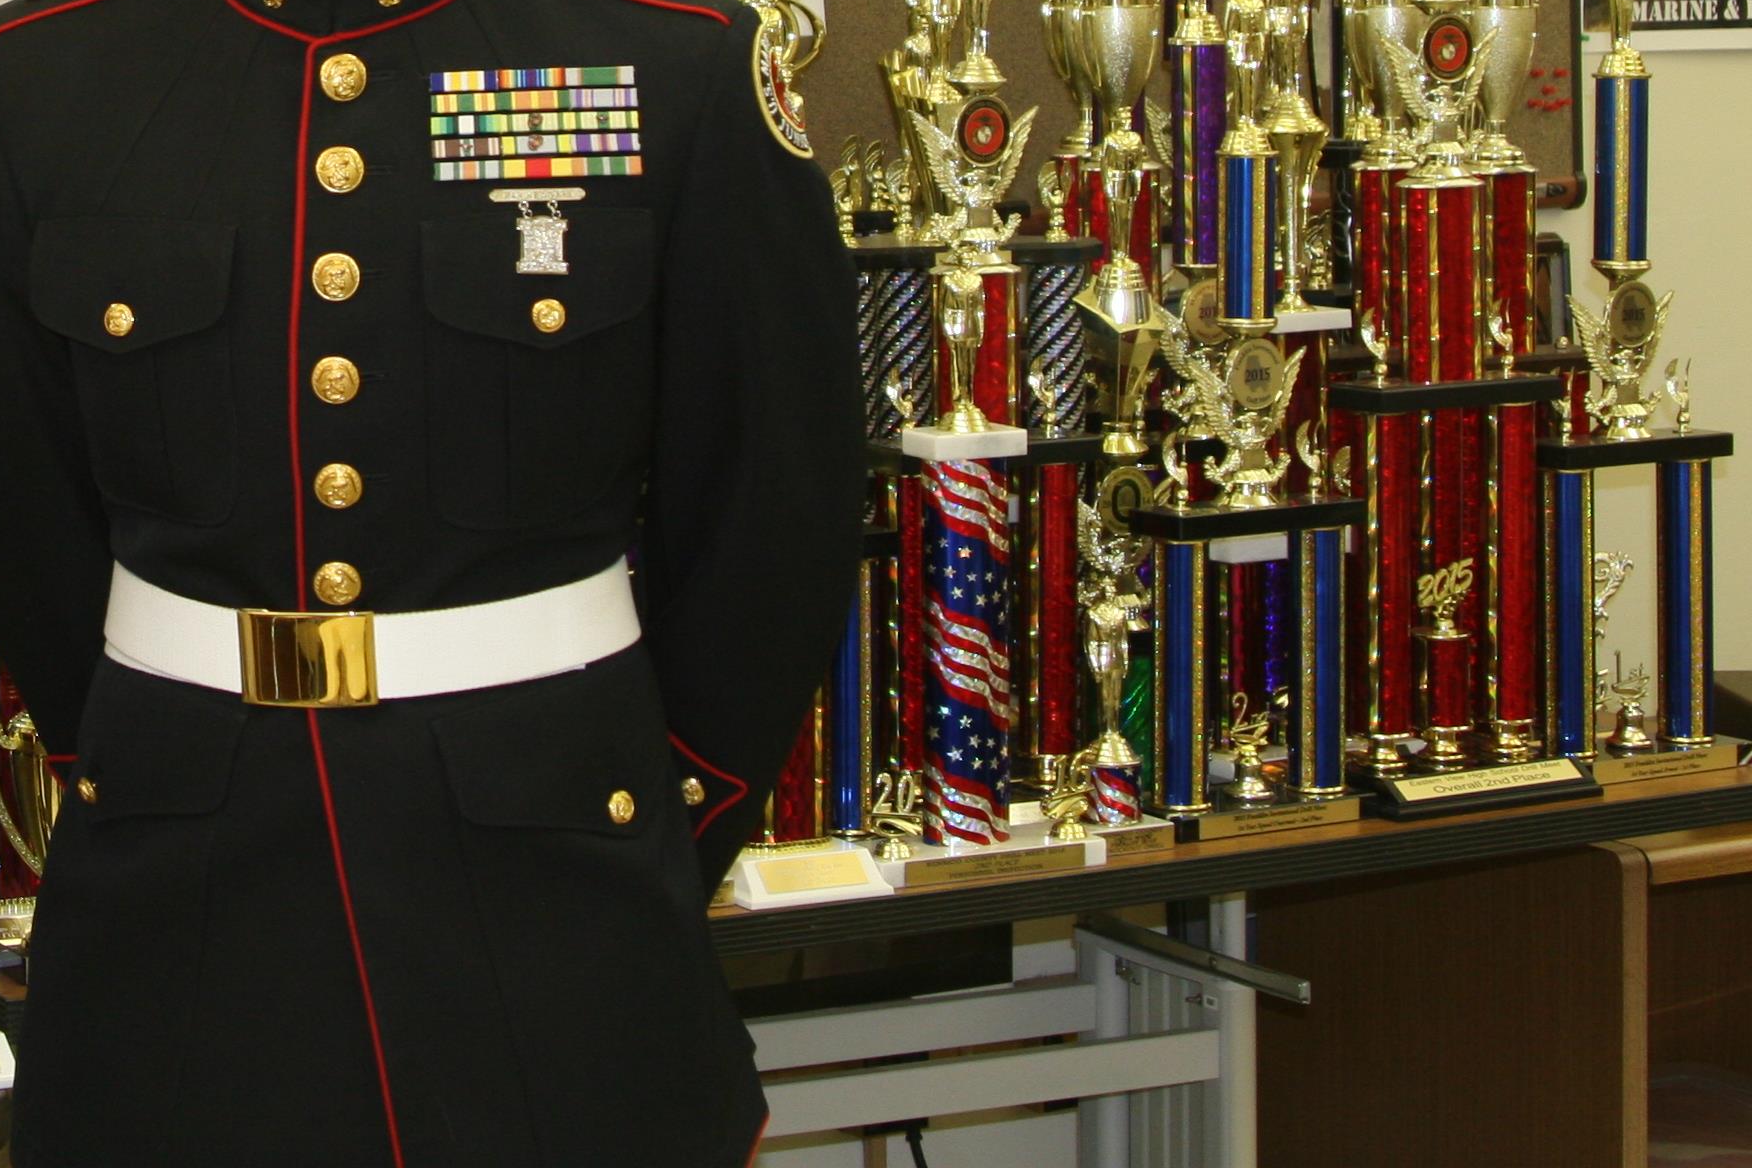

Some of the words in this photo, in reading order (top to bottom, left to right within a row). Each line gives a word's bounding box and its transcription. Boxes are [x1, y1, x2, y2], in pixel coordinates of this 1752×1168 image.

[1244, 367, 1271, 384] 2015
[1416, 557, 1474, 608] 2015
[1433, 781, 1483, 794] Overall
[1486, 777, 1510, 788] 2nd
[1514, 772, 1551, 784] Place
[1468, 771, 1487, 781] High
[1490, 767, 1519, 778] School
[872, 770, 916, 814] 20
